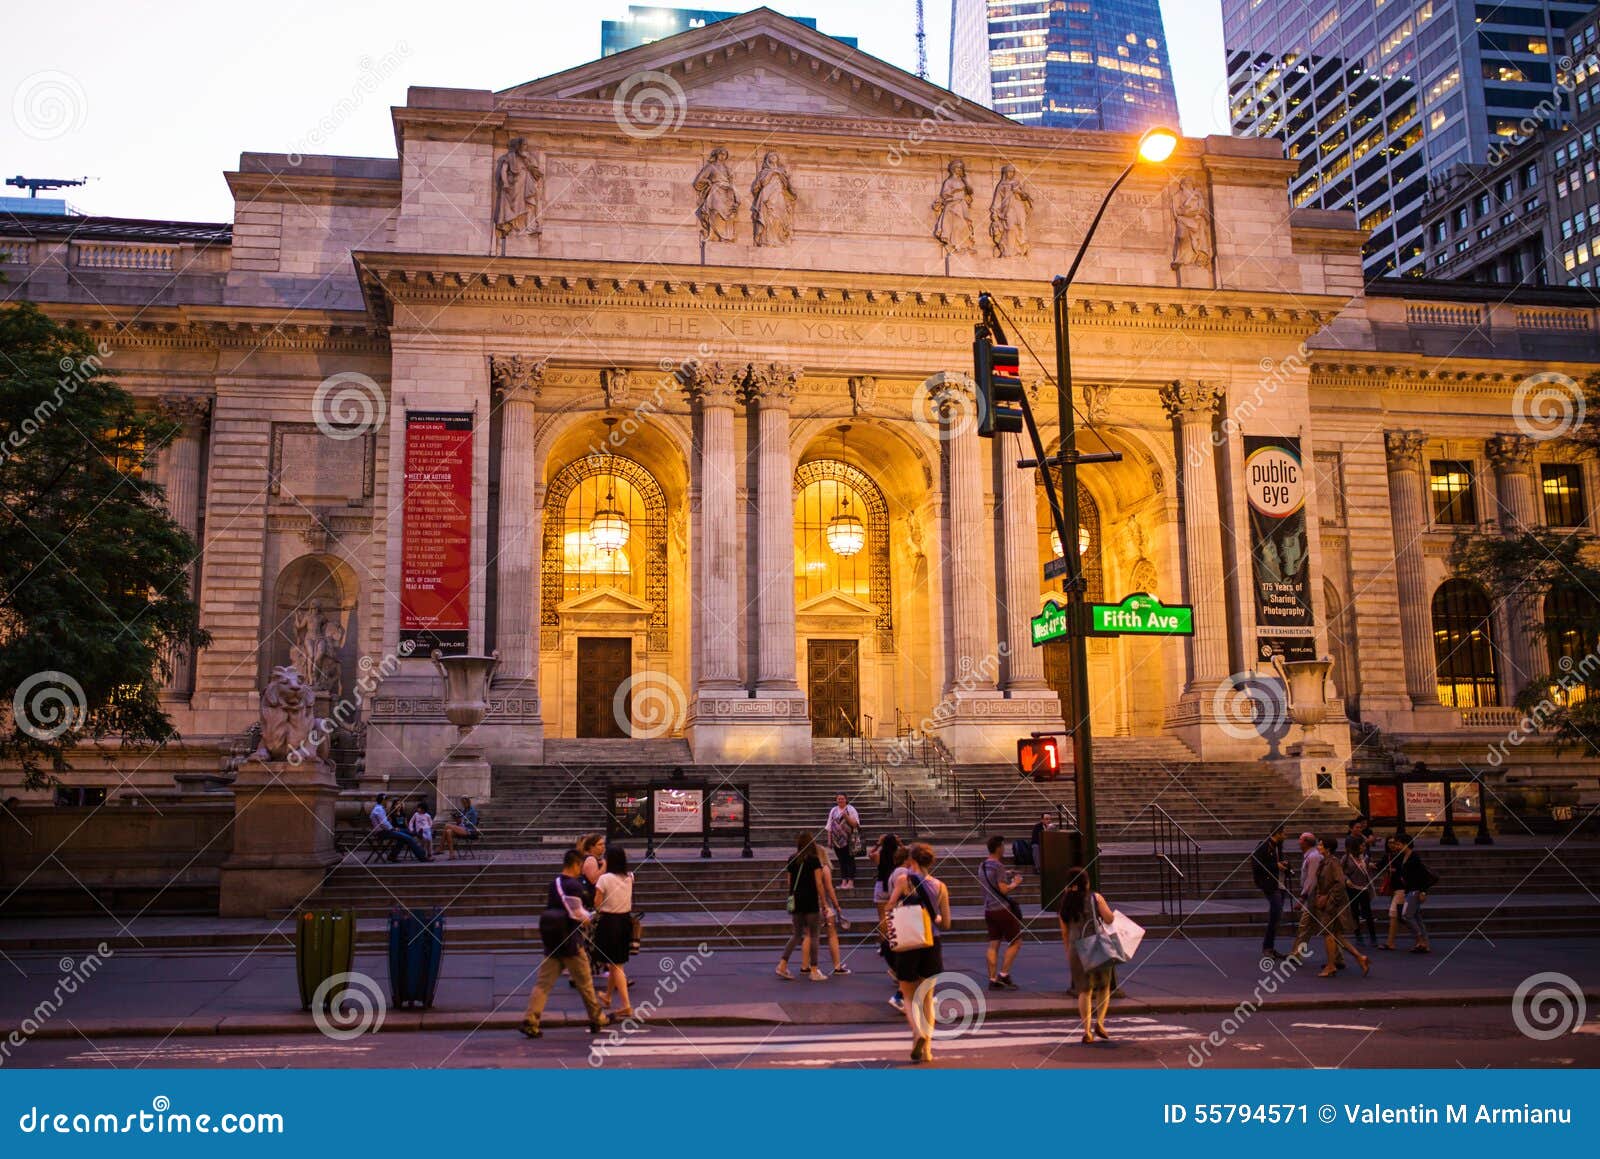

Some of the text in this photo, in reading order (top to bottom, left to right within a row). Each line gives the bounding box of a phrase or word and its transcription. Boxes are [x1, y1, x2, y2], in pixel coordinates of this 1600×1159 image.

[587, 163, 629, 176] ASTOR
[634, 166, 688, 178] LIBRARY
[502, 314, 594, 329] MDCCCXCV
[651, 316, 700, 334] THE
[720, 319, 780, 337] NEW
[802, 322, 864, 341] YORK
[885, 326, 967, 344] PUBLIC
[1252, 459, 1297, 486] public
[1263, 486, 1289, 507] eye
[1262, 582, 1303, 592] 175 Years of
[1270, 594, 1297, 605] Sharing
[1103, 610, 1178, 628] Fifth Ave
[1263, 606, 1305, 617] Photography
[1034, 621, 1049, 639] West
[677, 806, 698, 814] Library
